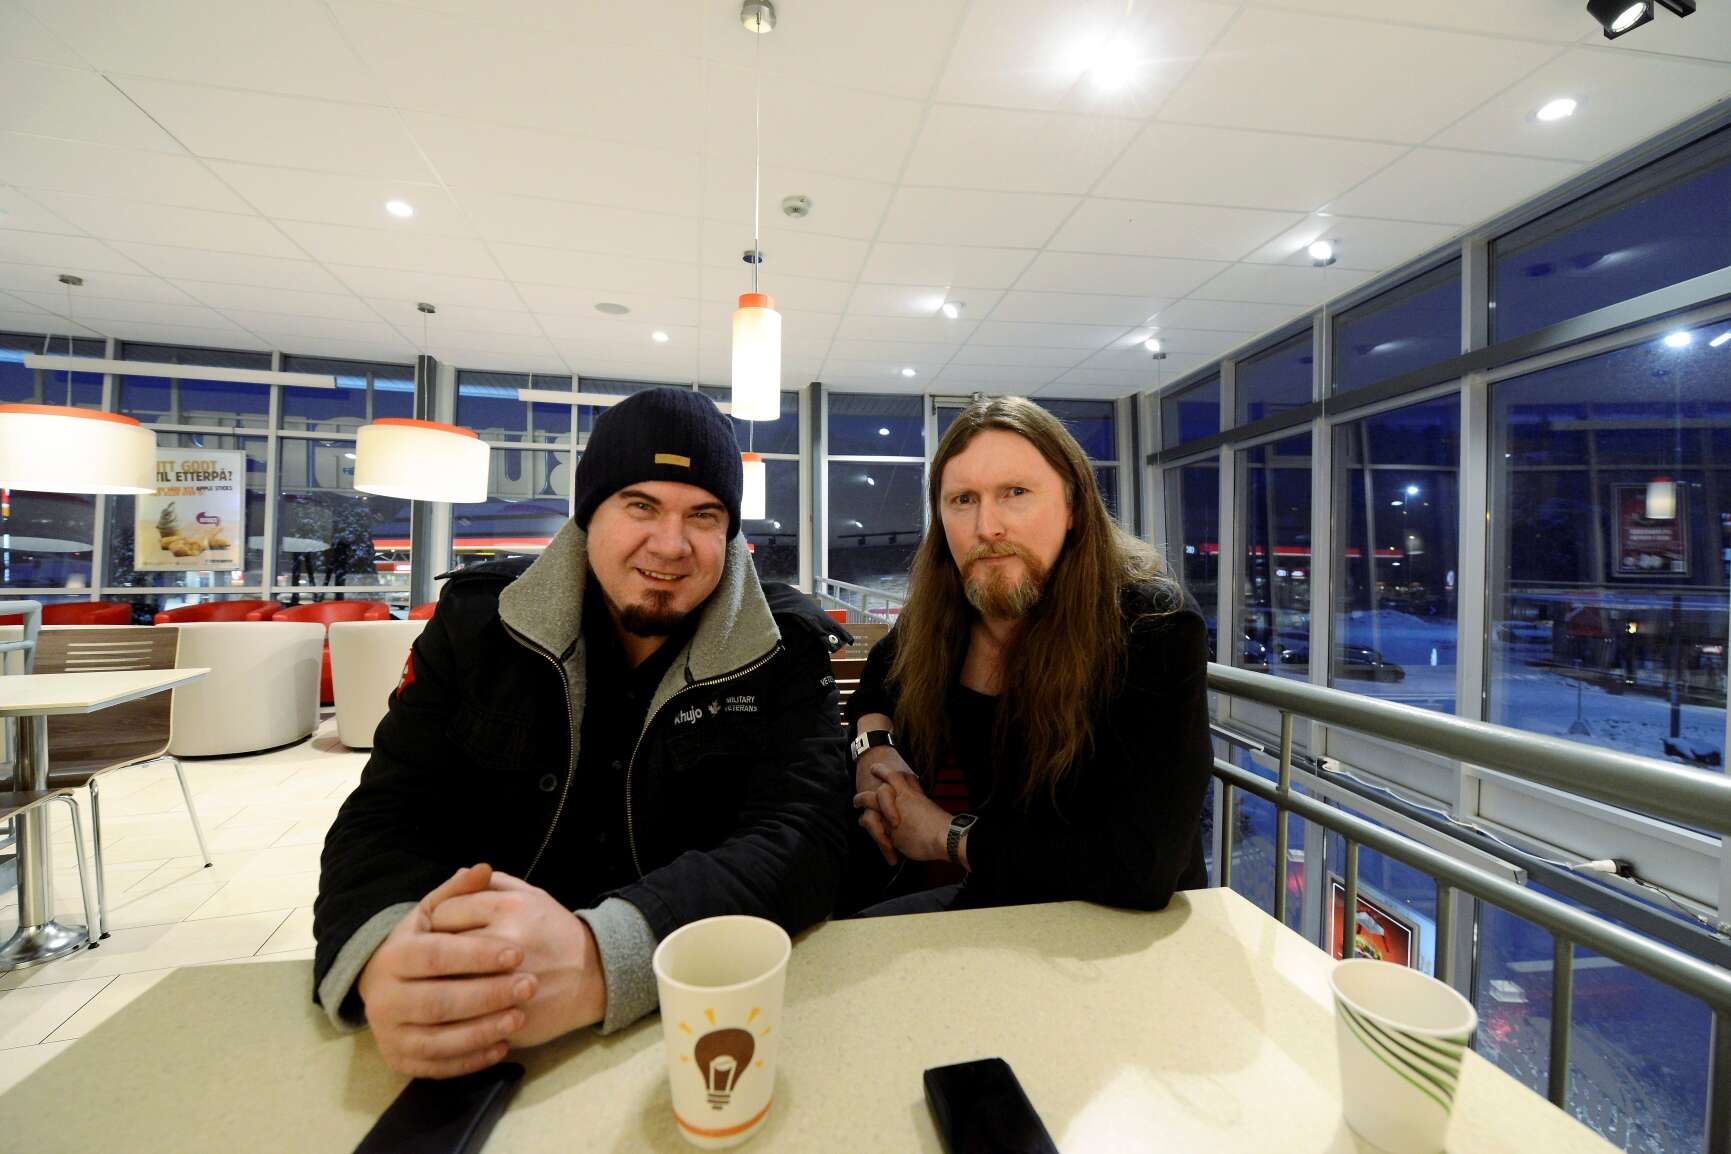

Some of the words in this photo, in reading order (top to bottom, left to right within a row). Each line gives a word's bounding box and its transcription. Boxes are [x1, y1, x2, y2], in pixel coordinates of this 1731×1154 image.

[156, 460, 176, 472] ITT
[181, 460, 217, 473] GODT
[175, 468, 232, 482] ETTERPÅ?
[725, 695, 755, 704] MILITARY
